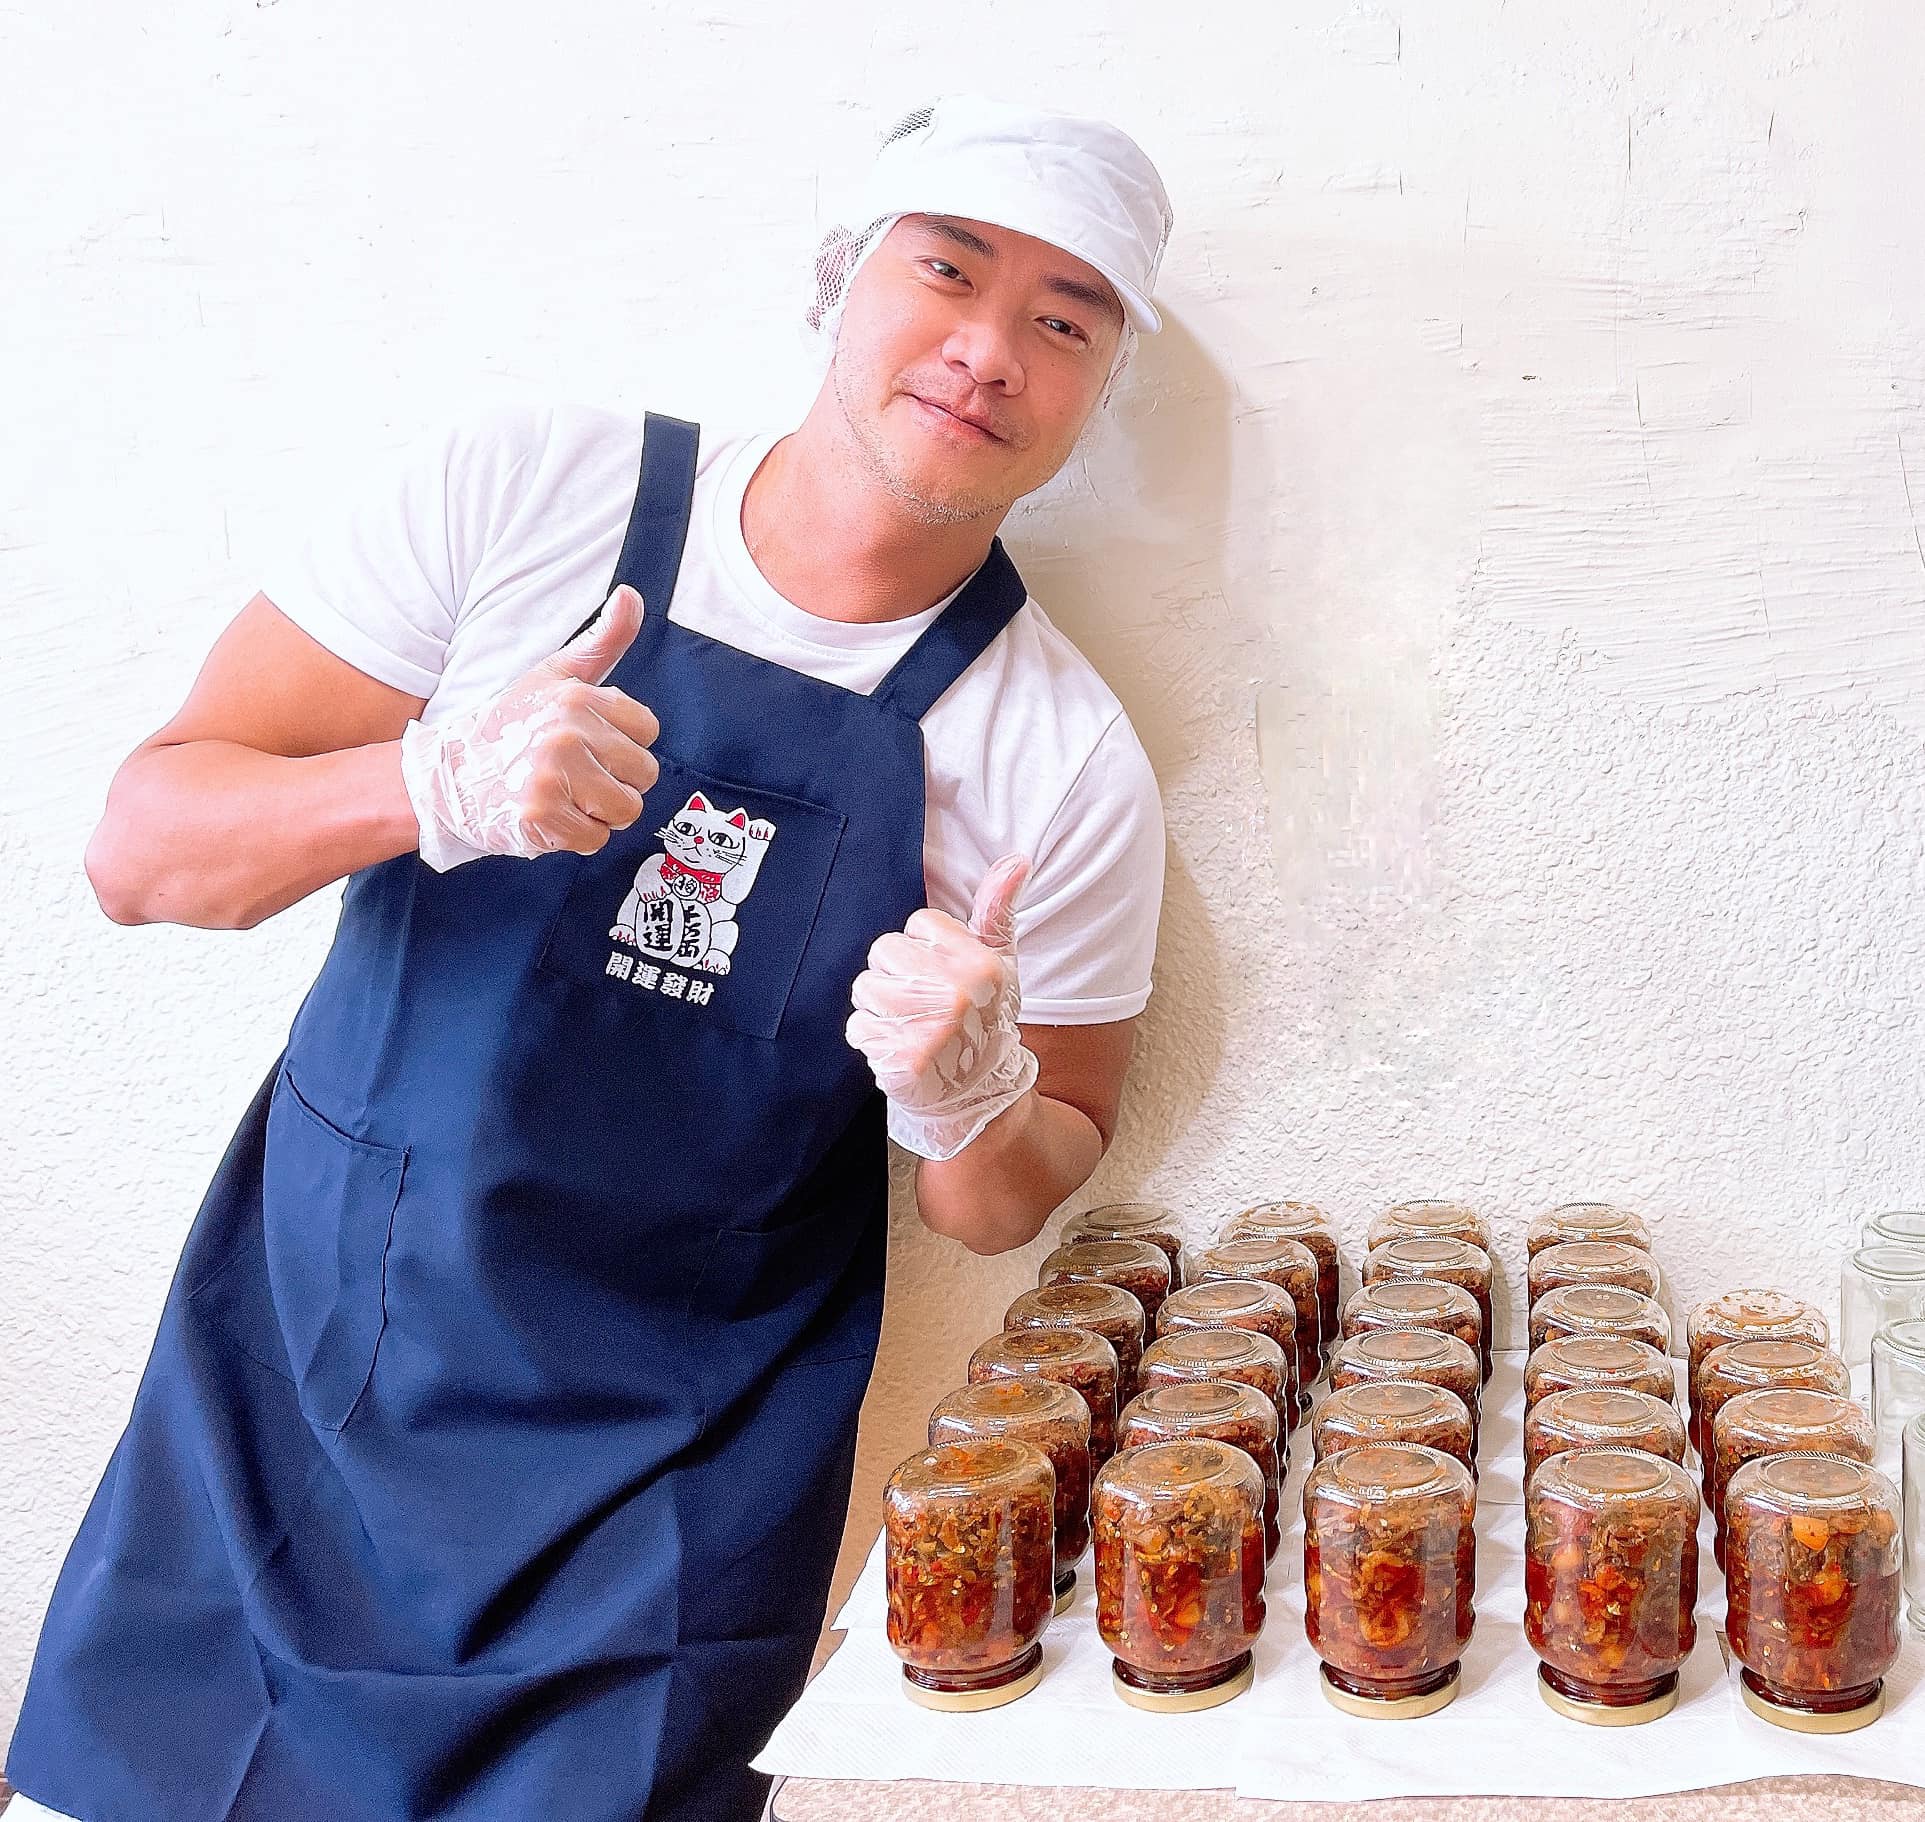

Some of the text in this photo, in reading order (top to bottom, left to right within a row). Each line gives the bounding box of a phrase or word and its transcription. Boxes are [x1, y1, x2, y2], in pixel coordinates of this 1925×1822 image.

[643, 899, 674, 951] 開運
[605, 951, 715, 1006] 開運發財
